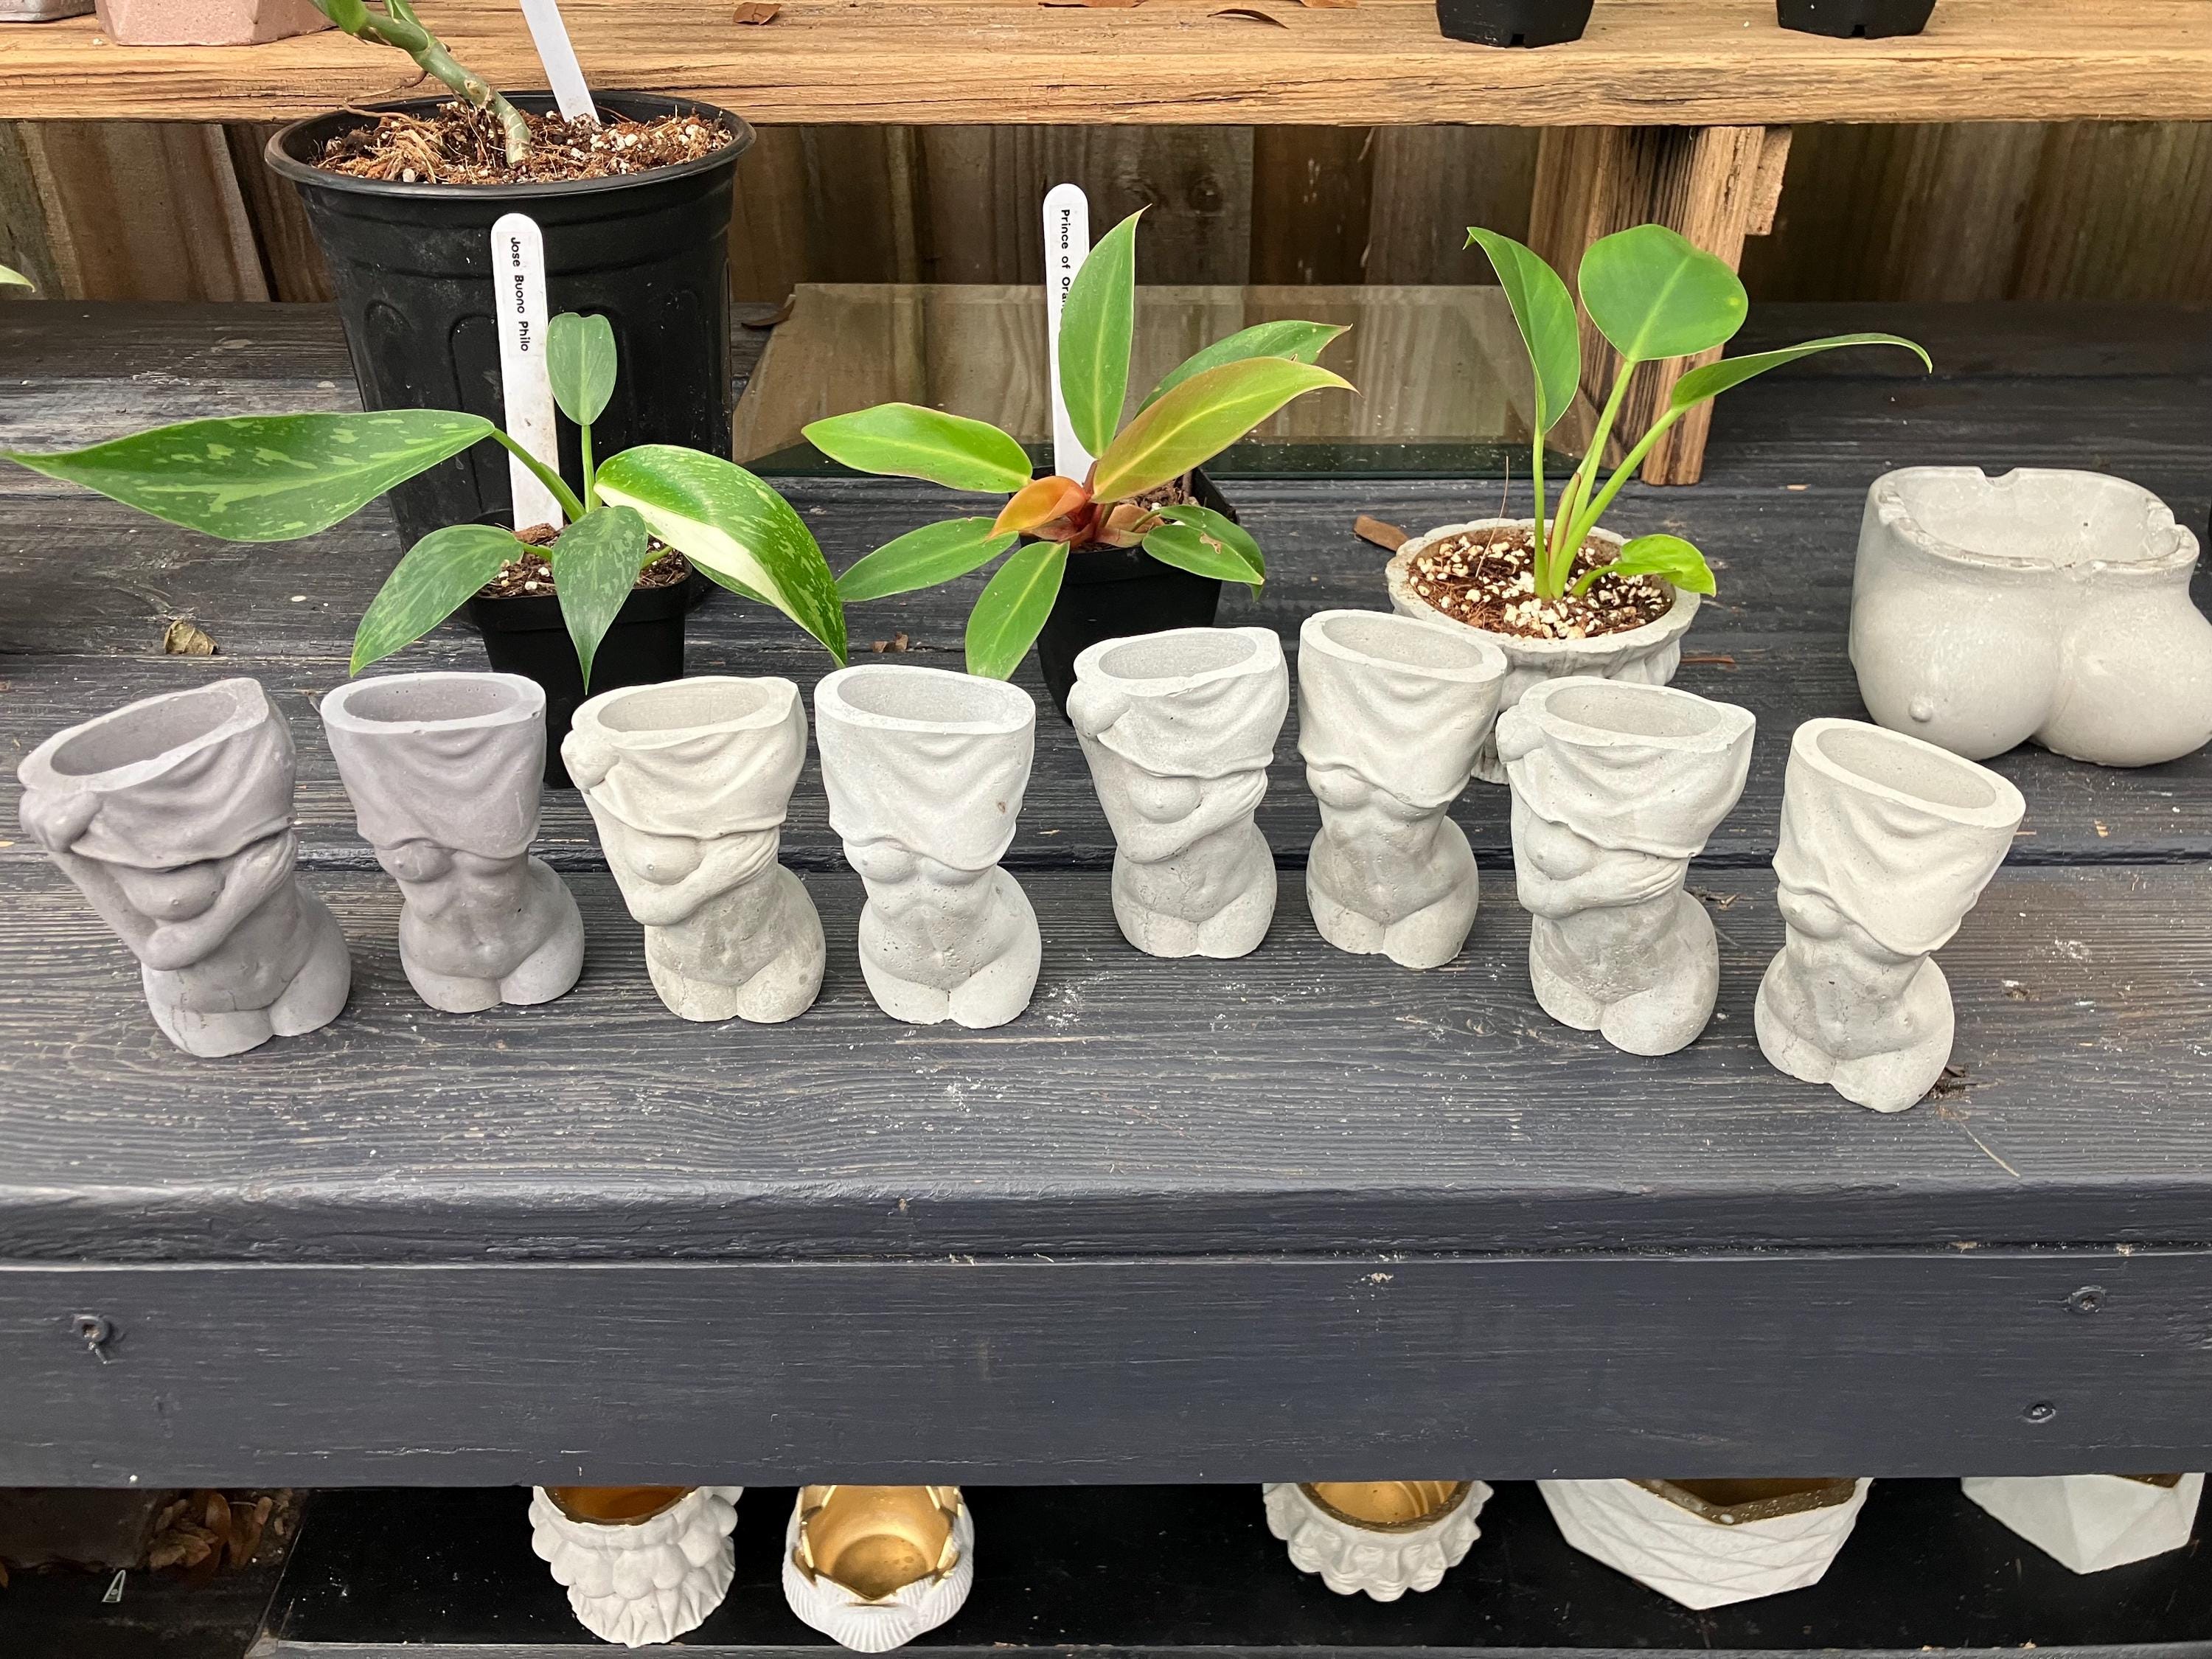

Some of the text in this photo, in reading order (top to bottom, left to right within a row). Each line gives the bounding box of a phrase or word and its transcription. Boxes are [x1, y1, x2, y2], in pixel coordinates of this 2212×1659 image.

[510, 237, 530, 352] Jose Buono Philo
[1061, 209, 1071, 313] Prince of Ora
